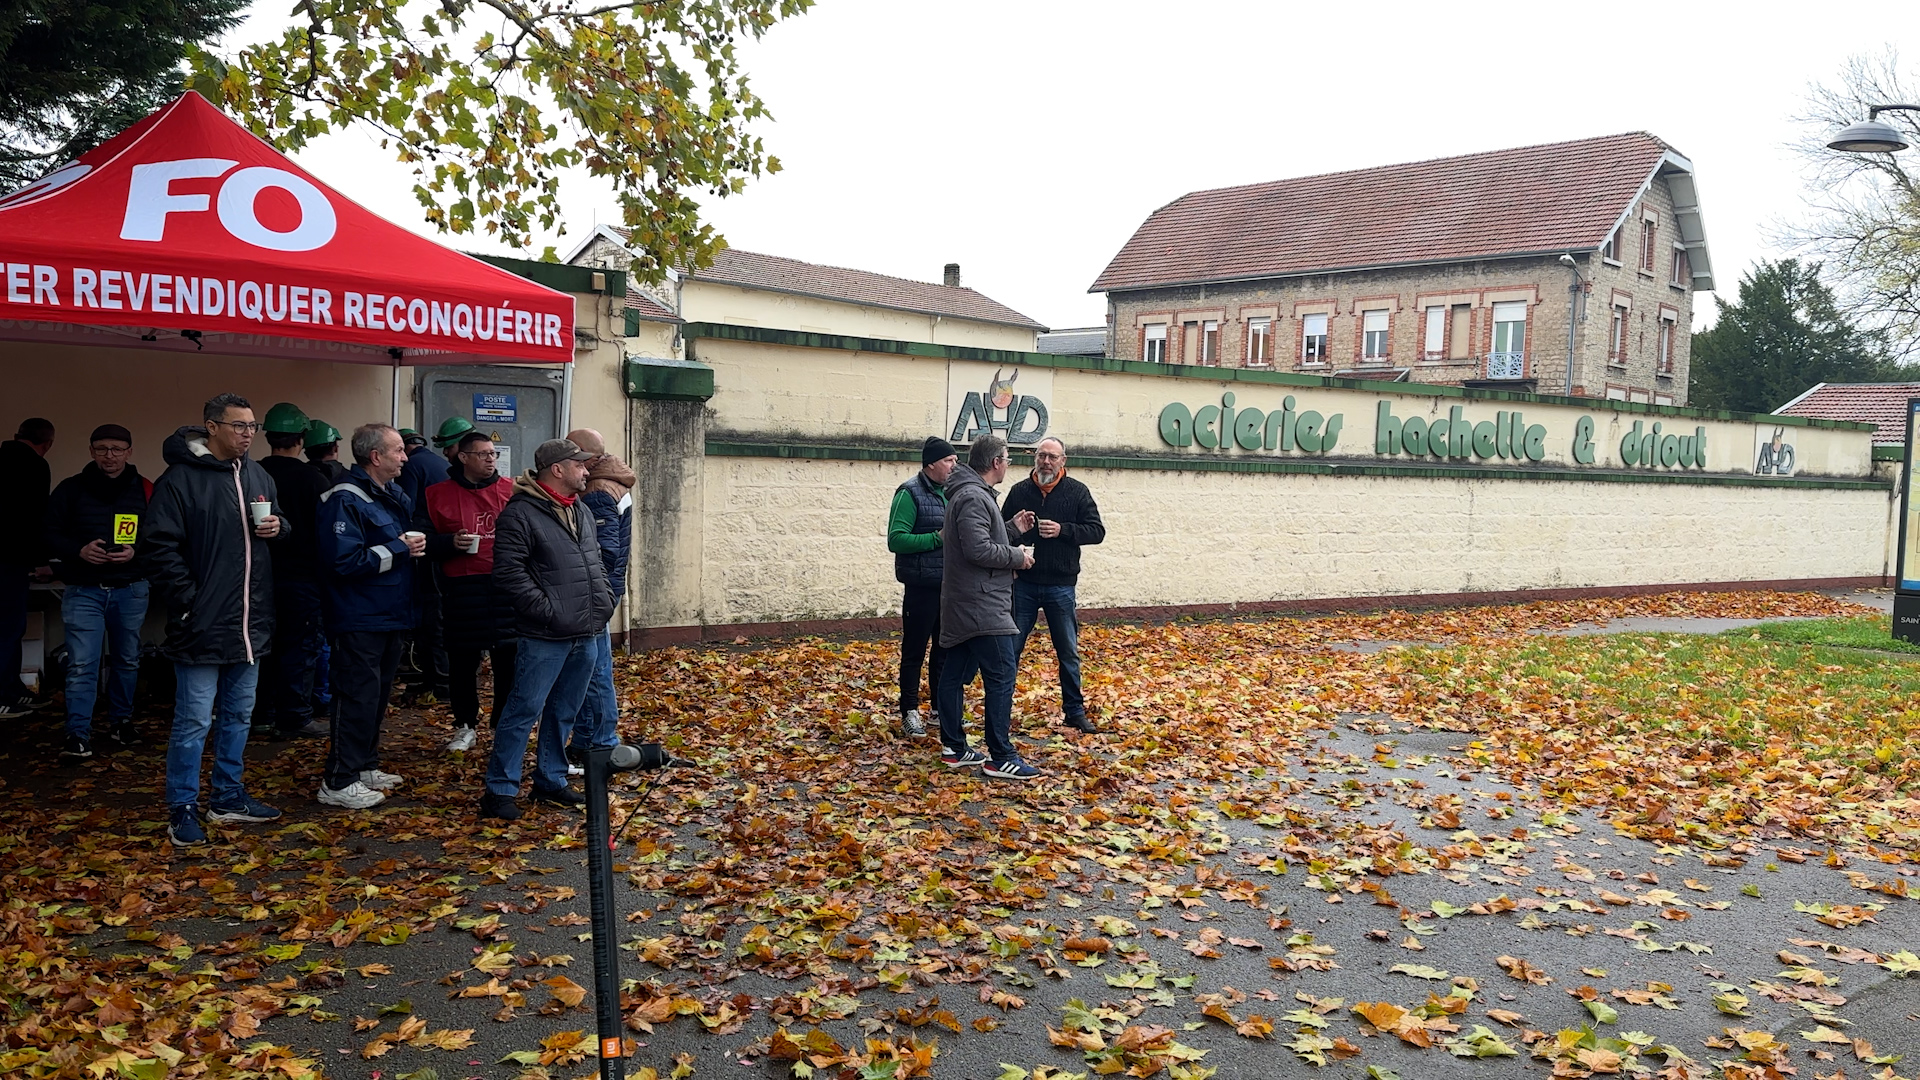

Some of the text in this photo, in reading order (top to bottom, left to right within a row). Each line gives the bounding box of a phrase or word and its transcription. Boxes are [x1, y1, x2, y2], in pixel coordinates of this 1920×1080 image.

[119, 158, 337, 252] FO
[0, 262, 61, 306] ER
[73, 268, 334, 325] REVENDIQUER
[344, 291, 563, 347] RECONQUÉRIR
[950, 391, 1049, 445] AHD
[1159, 391, 1707, 468] acieries hachette & driout
[1756, 442, 1795, 475] AHD
[118, 521, 135, 535] FO
[472, 510, 497, 535] FO
[1901, 616, 1920, 624] SAIN
